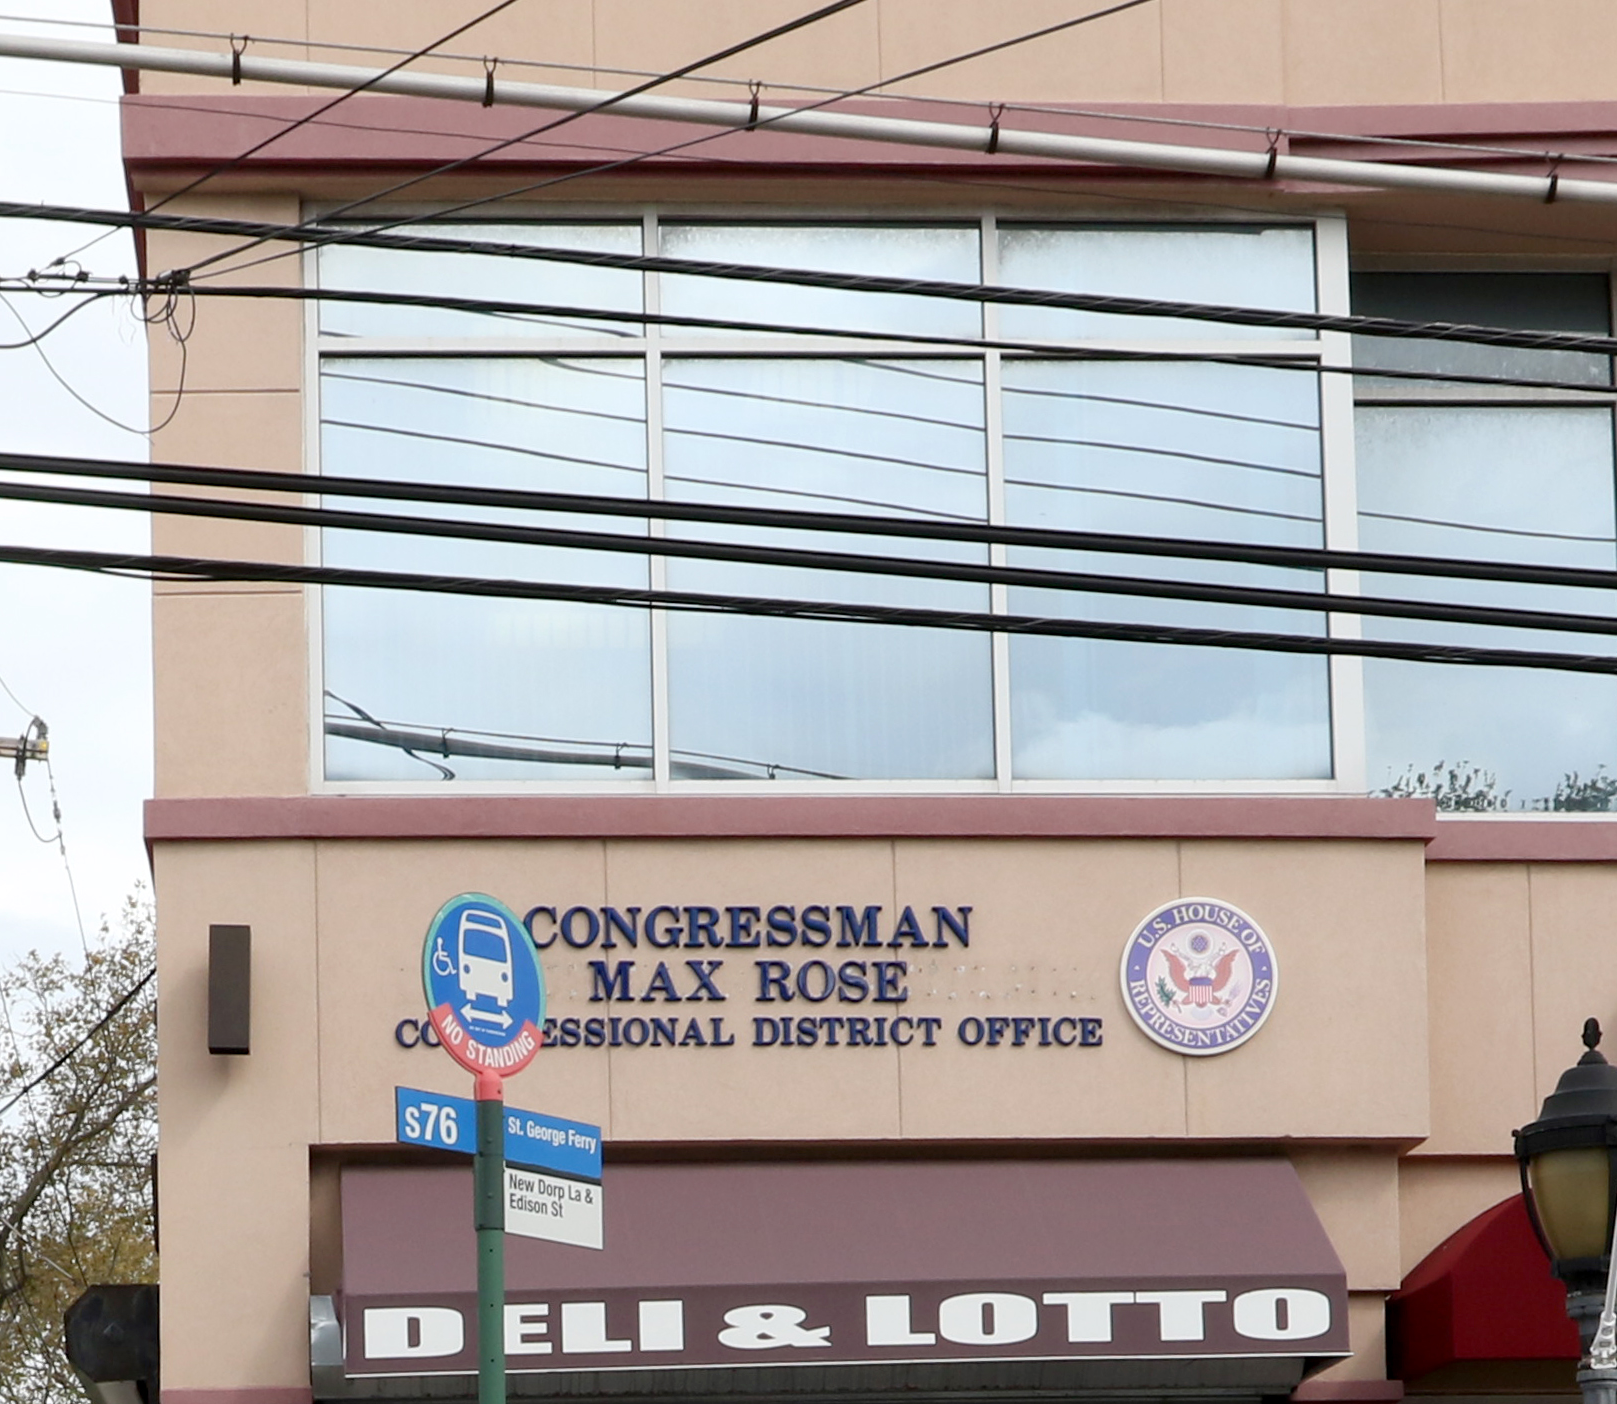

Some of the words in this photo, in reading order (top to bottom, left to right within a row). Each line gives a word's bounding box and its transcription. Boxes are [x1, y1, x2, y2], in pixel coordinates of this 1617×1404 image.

[524, 905, 973, 949] CONGRESSMAN
[1137, 917, 1171, 949] U.S.
[1171, 904, 1243, 933] HOUSE
[1240, 929, 1266, 954] OF
[589, 960, 726, 1003] MAX
[756, 960, 909, 1003] ROSE
[395, 1016, 735, 1049] COESSIONAL
[753, 1016, 942, 1047] DISTRICT
[958, 1016, 1104, 1047] OFFICE
[1130, 978, 1271, 1047] REPRESENTATIVES
[441, 1014, 462, 1046] NO
[465, 1030, 536, 1069] STANDING
[404, 1101, 459, 1146] S76
[508, 1115, 524, 1137] St.
[526, 1120, 566, 1147] George
[568, 1129, 597, 1155] Ferry
[509, 1173, 535, 1194] New
[537, 1177, 565, 1203] Dorp
[568, 1182, 582, 1203] La
[584, 1184, 594, 1205] &
[509, 1193, 548, 1216] Edison
[550, 1200, 564, 1219] St
[363, 1299, 685, 1361] DELI
[718, 1304, 832, 1351] &
[865, 1288, 1333, 1349] LOTTO
